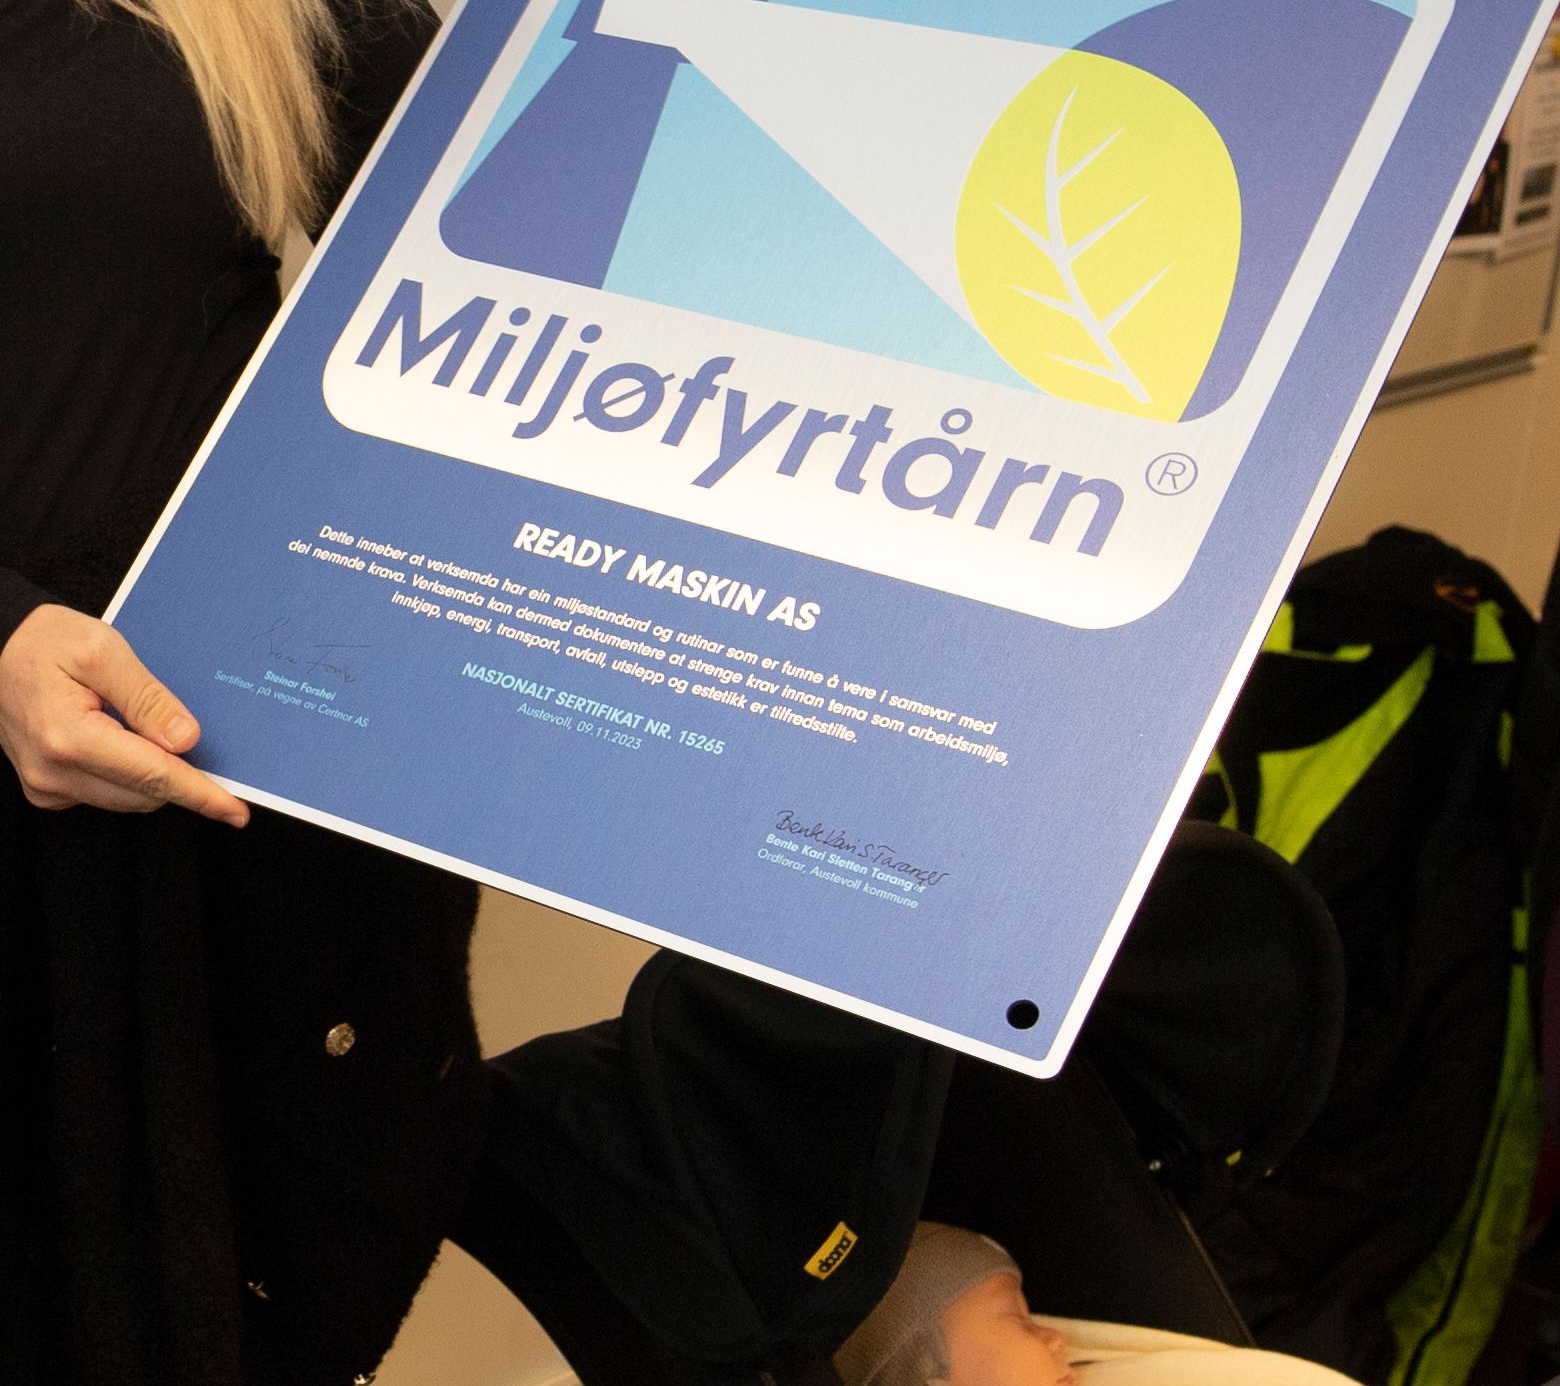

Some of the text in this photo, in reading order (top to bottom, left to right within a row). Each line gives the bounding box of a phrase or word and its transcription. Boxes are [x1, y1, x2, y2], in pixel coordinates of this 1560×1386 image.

[355, 278, 1126, 558] Miljøfyrtårn
[513, 522, 821, 631] READY MASKIN AS
[288, 538, 1009, 767] dei nemnde krava. Verksemda kan dermed dokumentere at strenge krav innan tema som arbeidsmiljø,
[319, 525, 998, 736] Dette inneber at verksemda har ein miljøstandard og rutinar som er funne å vere i samsvar med
[391, 590, 858, 744] innkjøp, energi, transport, avfall, utslepp og estetikk er tilfredsstilte.
[256, 685, 272, 696] på
[274, 691, 303, 706] vegne
[303, 701, 317, 710] av
[354, 715, 371, 728] AS
[263, 670, 300, 689] Steinar
[462, 662, 726, 755] NASJONALT SERTIFIKAT NR. 15265
[517, 702, 643, 750] Austevoll, 09.11.2023
[757, 848, 919, 909] Ordførar, Austevoll kommune
[766, 832, 799, 852] Bente
[802, 844, 827, 861] Kari
[828, 853, 869, 875] Sletten
